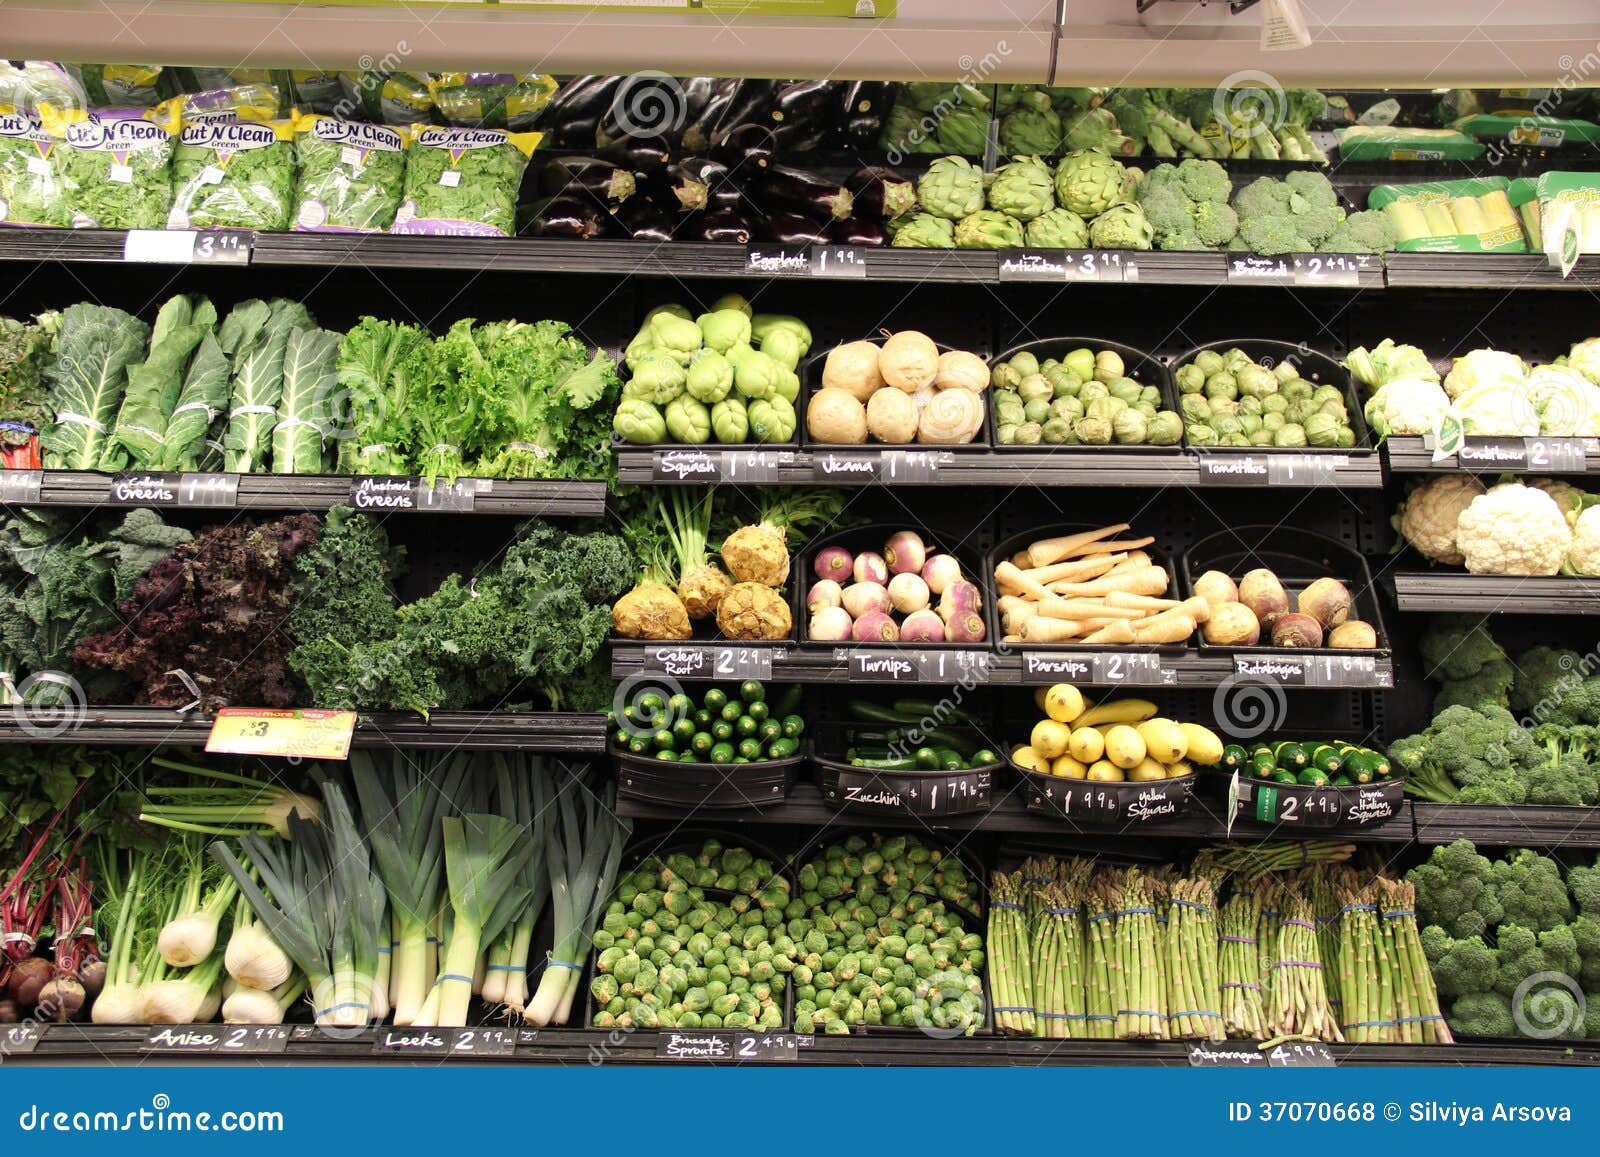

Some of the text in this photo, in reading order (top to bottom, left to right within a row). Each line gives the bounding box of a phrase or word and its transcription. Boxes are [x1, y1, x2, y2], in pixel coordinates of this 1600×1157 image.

[181, 122, 274, 144] Cut N Clean
[314, 119, 401, 149] Cut N Clean
[349, 136, 376, 148] Greens
[463, 130, 507, 145] Clean
[211, 140, 240, 149] Greens
[197, 237, 214, 258] 3
[750, 250, 807, 270] Eggplant
[1079, 253, 1097, 274] 3
[1101, 252, 1120, 267] 99
[1305, 257, 1328, 280] 2
[1326, 256, 1345, 272] 49
[1531, 441, 1549, 465] 2
[661, 457, 716, 480] Squash
[116, 484, 174, 502] Greens
[360, 478, 412, 492] Mustard
[355, 489, 413, 508] Greens
[655, 647, 704, 669] Celery
[664, 661, 694, 675] Root
[717, 650, 735, 674] 2
[739, 650, 759, 665] 29
[854, 654, 912, 680] Turnips
[1027, 655, 1089, 679] Parsnips
[1107, 654, 1125, 679] 2
[1236, 660, 1302, 680] Rutabagas
[844, 787, 900, 806] Zucchini
[948, 781, 967, 798] 79
[1084, 792, 1105, 808] 99
[1127, 801, 1175, 821] Squash
[1279, 796, 1299, 821] 2
[1304, 796, 1327, 813] 49
[1347, 804, 1393, 825] Squash
[150, 1028, 219, 1047] Anise
[224, 1028, 249, 1048] 2
[255, 1029, 277, 1042] 99
[385, 1032, 445, 1047] Leeks
[455, 1031, 475, 1050] 2
[483, 1031, 503, 1044] 99
[666, 1043, 726, 1058] Sprouts
[739, 1037, 758, 1057] 2
[763, 1036, 784, 1049] 49
[1190, 1047, 1264, 1064] Asparagus
[1271, 1045, 1291, 1067] 4
[1294, 1045, 1316, 1057] 99
